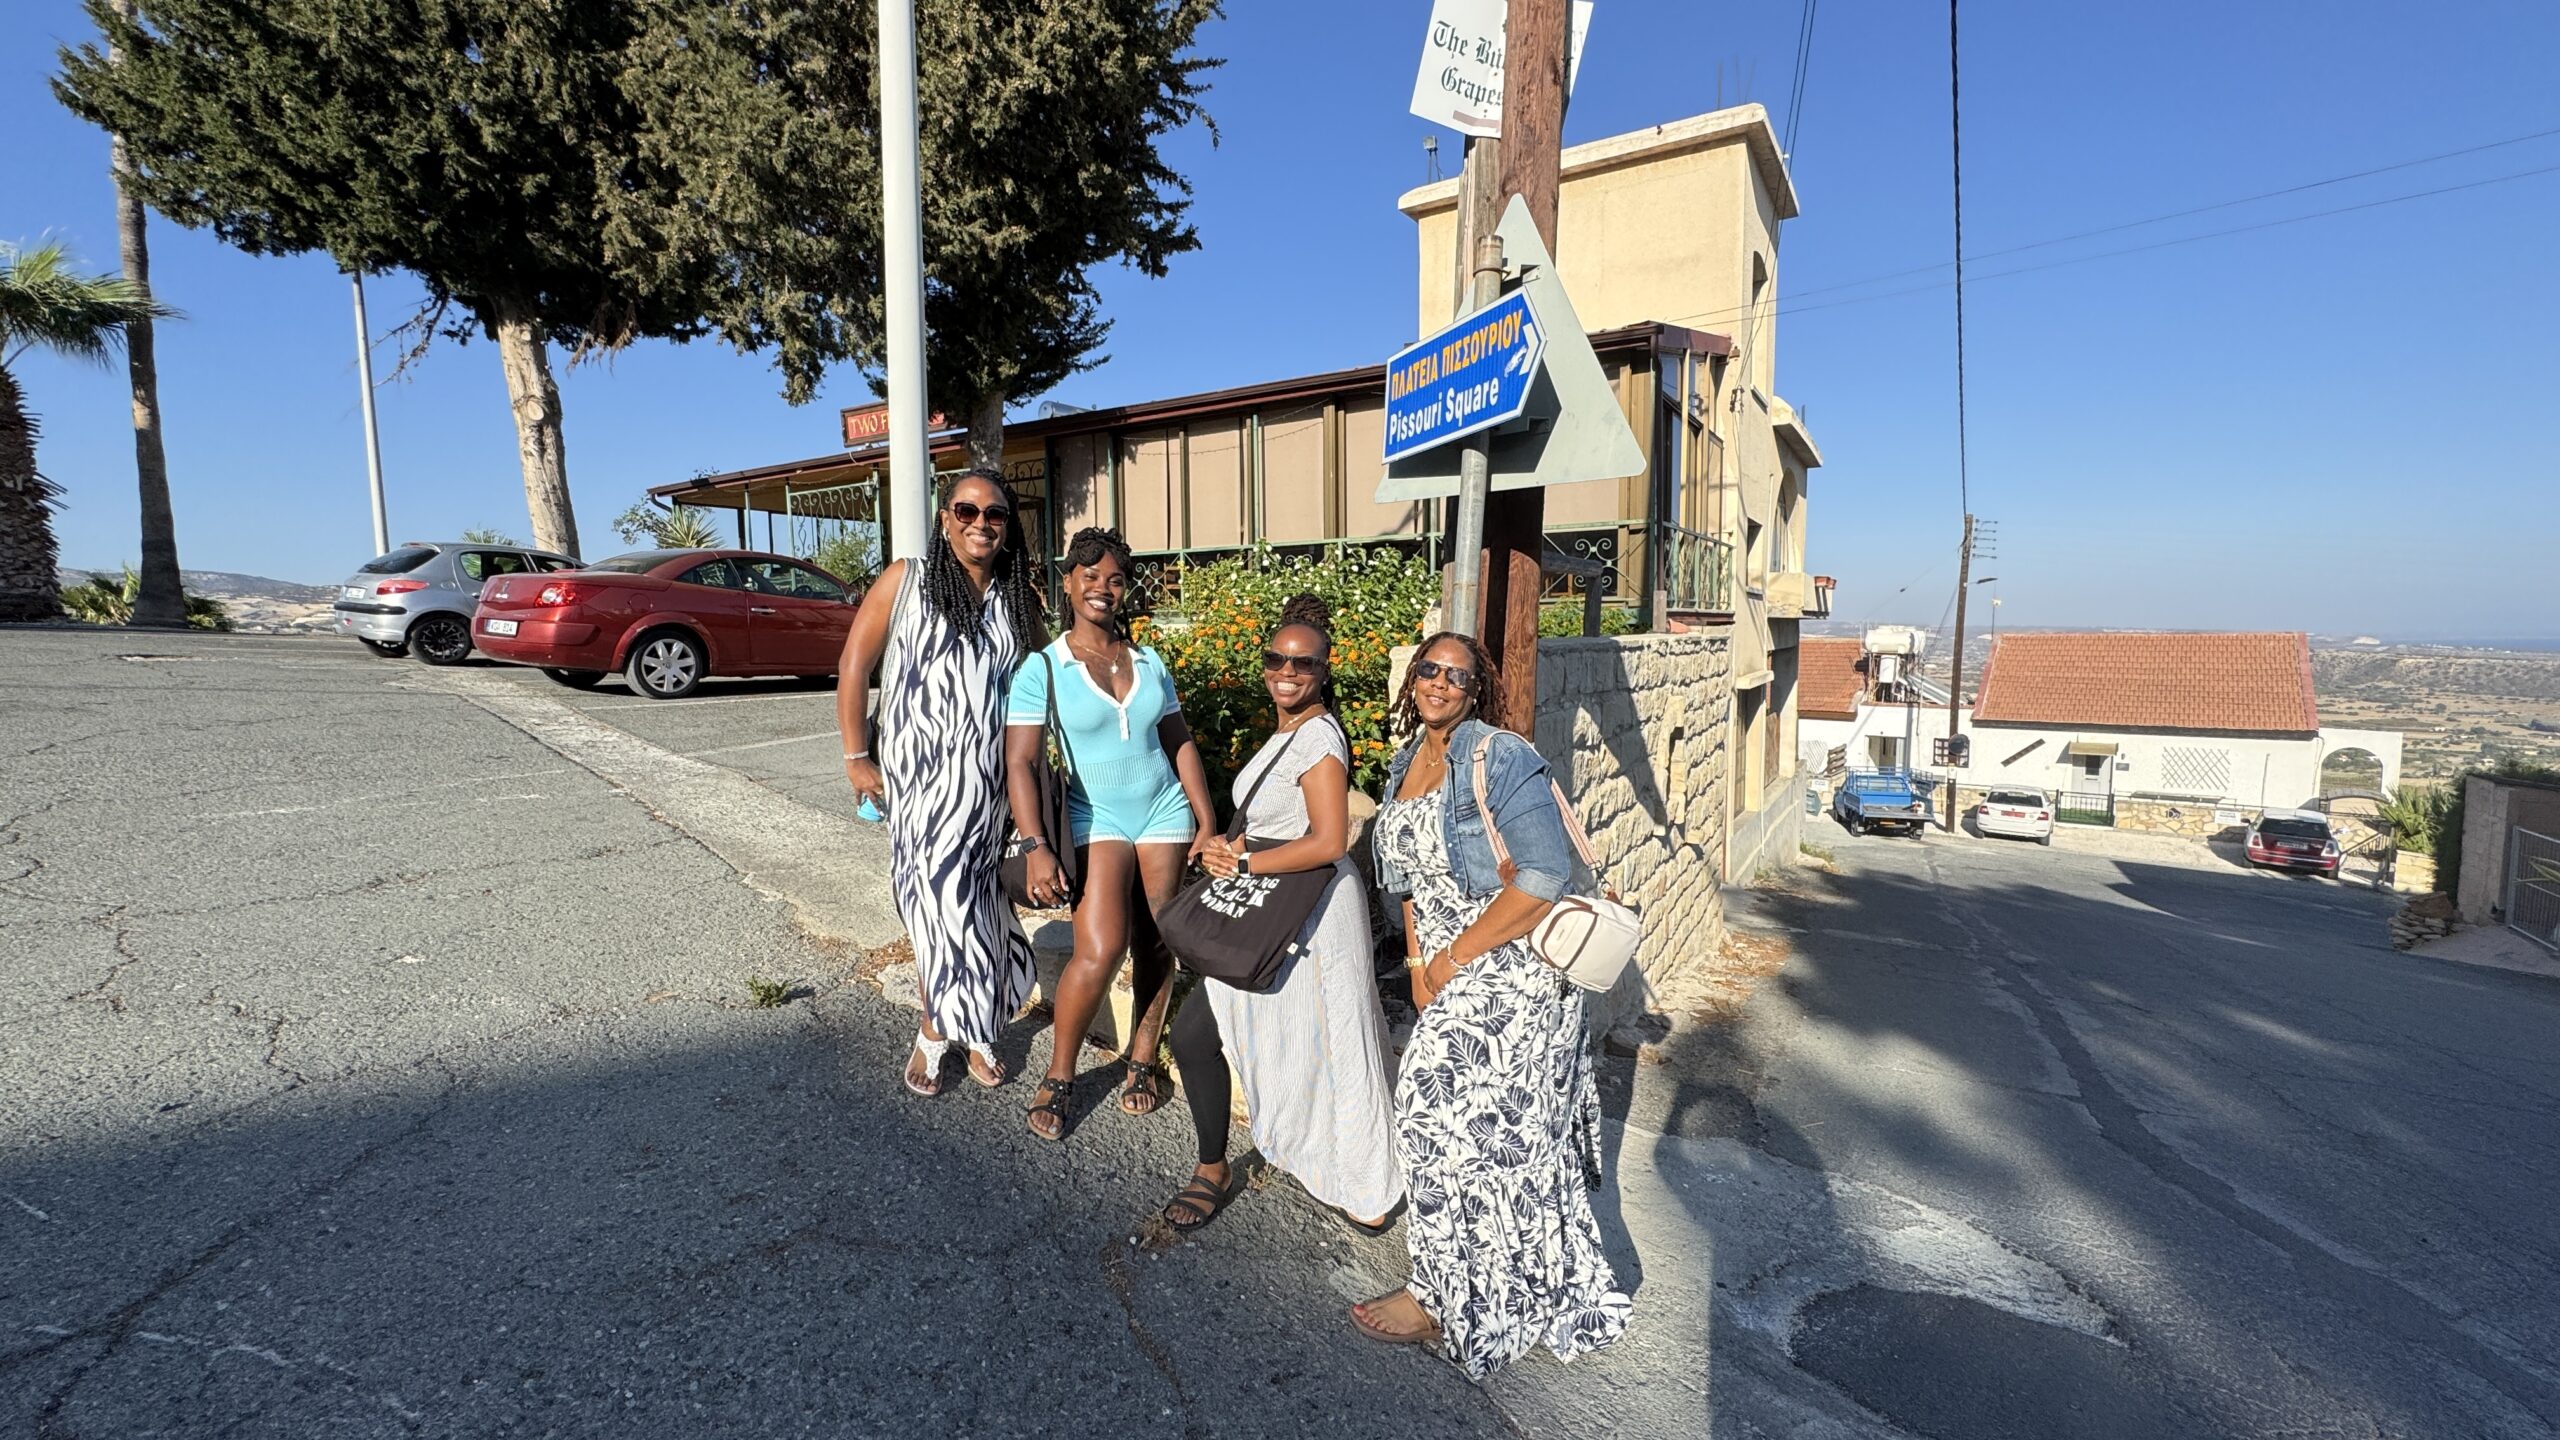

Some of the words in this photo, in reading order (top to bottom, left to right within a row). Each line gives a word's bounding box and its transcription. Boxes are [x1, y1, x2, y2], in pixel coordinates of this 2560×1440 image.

[1433, 20, 1468, 59] The
[1391, 352, 1438, 402] ΠΛΑΤΕΙΑ
[1442, 309, 1523, 378] ΠΙΣΣΟΥΡΙΟΥ
[849, 413, 878, 434] TWO
[1389, 392, 1443, 445] Pissouri
[1445, 377, 1499, 427] Square
[1200, 888, 1249, 918] WOMAN
